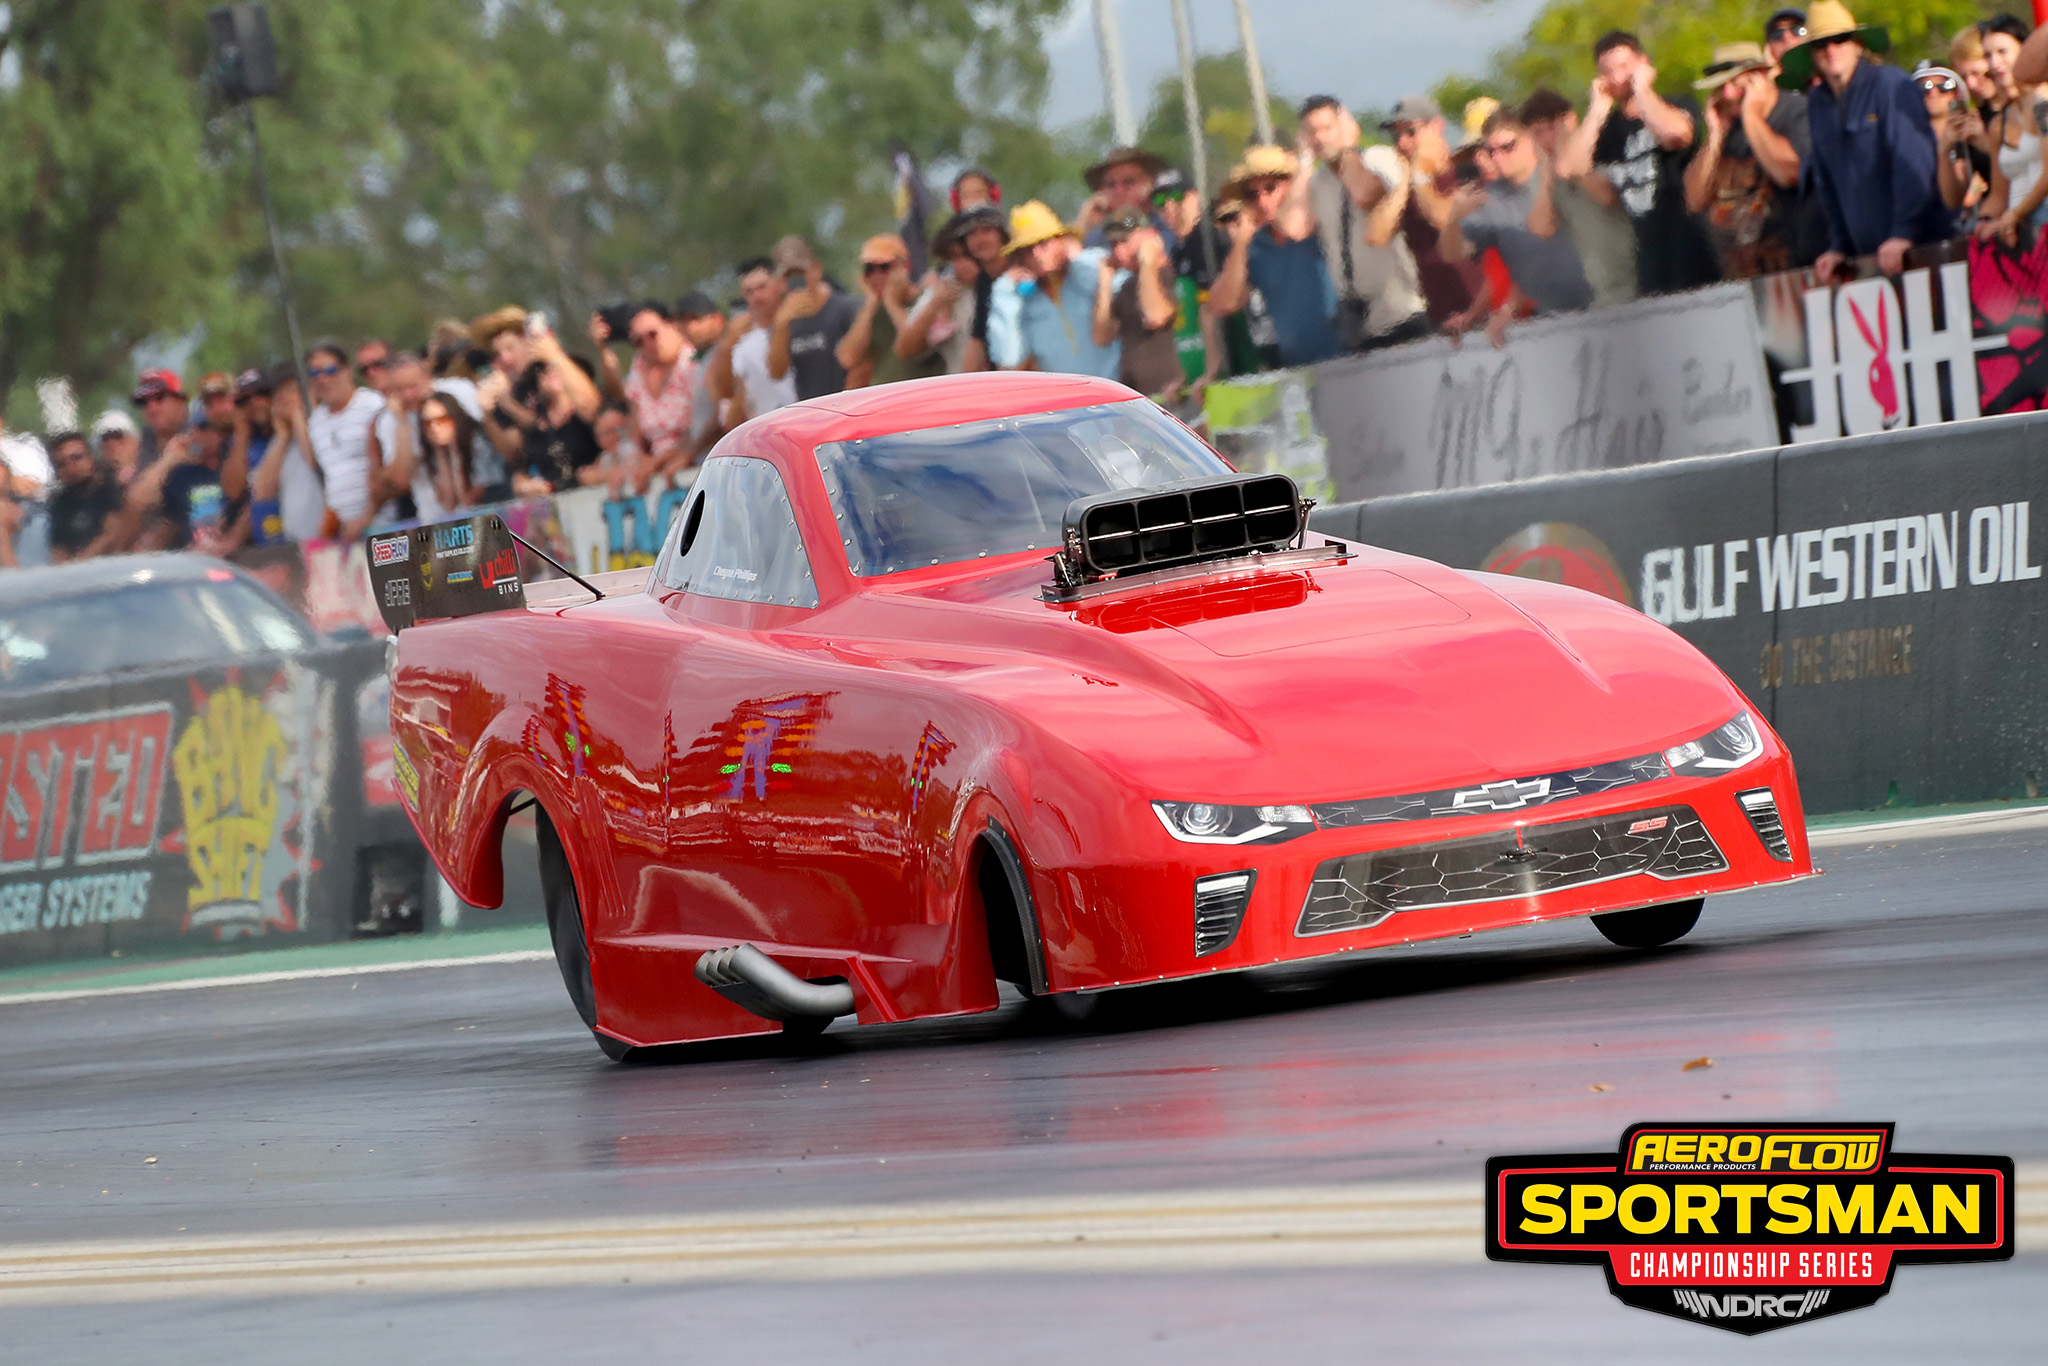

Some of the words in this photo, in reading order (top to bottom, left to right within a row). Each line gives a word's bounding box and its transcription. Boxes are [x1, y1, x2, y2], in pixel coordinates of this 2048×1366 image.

[433, 525, 475, 550] HARTS
[1642, 539, 1749, 625] GULF
[1756, 511, 1958, 613] WESTERN
[1969, 501, 2043, 586] OIL
[498, 582, 520, 595] BINS
[1628, 816, 1669, 834] SS
[42, 871, 152, 929] SYSTEMS
